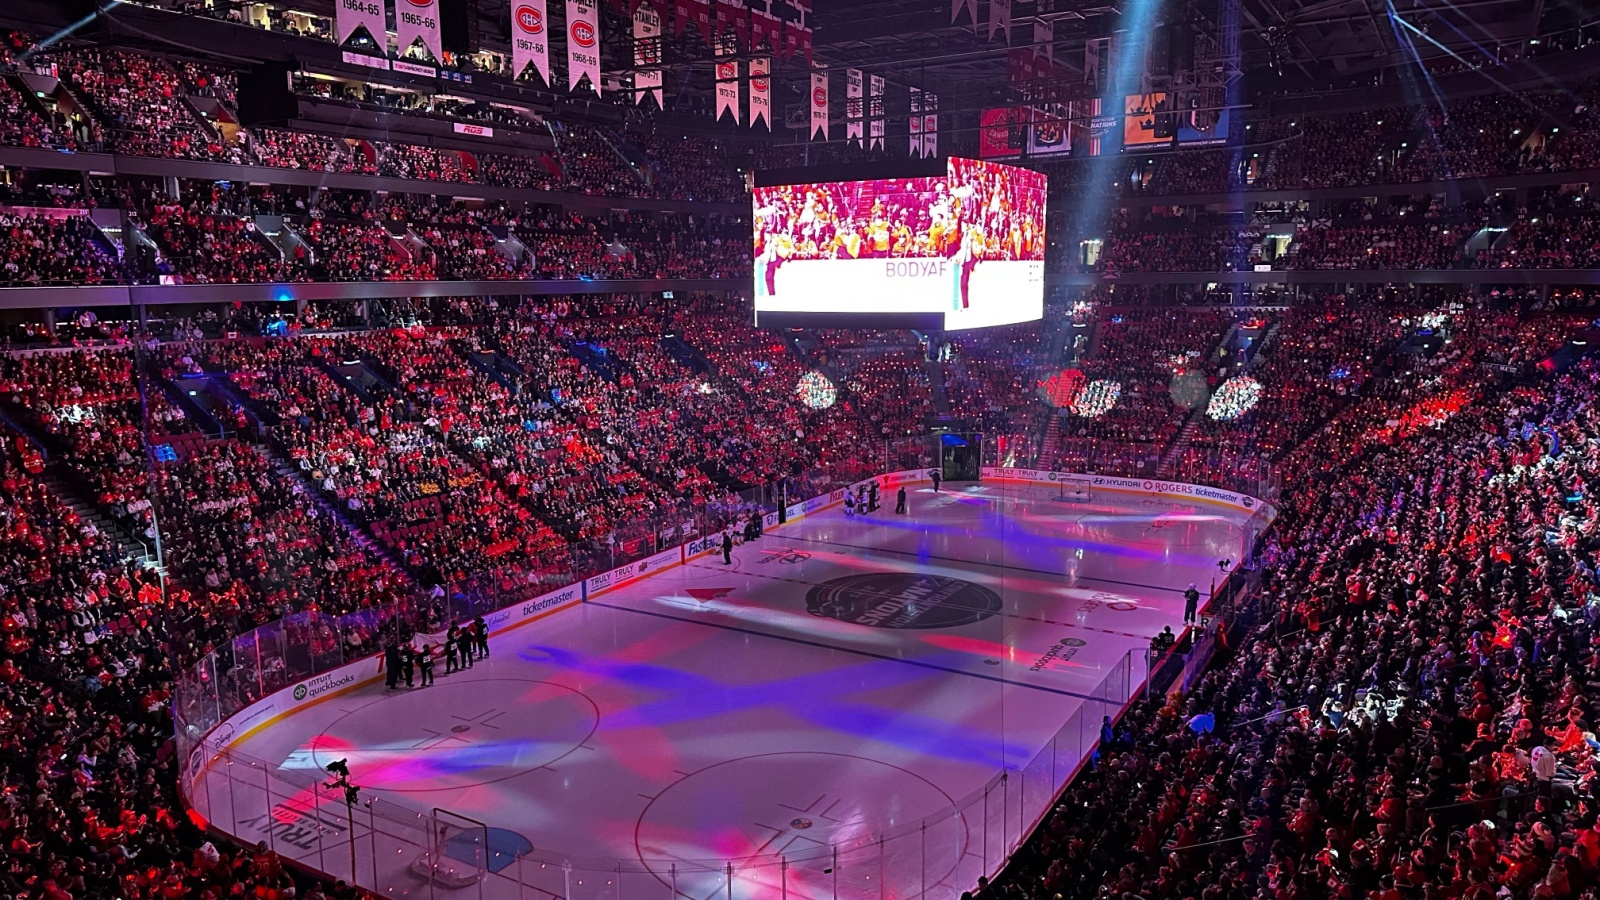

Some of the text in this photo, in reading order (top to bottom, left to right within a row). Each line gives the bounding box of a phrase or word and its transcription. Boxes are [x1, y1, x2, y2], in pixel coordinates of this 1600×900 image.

[342, 0, 380, 16] 1964-65
[400, 12, 436, 29] 1965-66
[634, 10, 660, 28] STANLEY
[516, 38, 544, 54] 1967-68
[571, 52, 597, 66] 1968-69
[718, 87, 737, 99] 1972-73
[464, 125, 484, 135] RDS
[1090, 121, 1117, 129] NATIONS
[994, 468, 1014, 476] TRULY
[1018, 469, 1038, 477] TRULY
[1106, 479, 1141, 488] HYUNDAI
[1155, 482, 1193, 494] ROGERS
[1195, 487, 1238, 503] ticketmaster
[614, 565, 634, 577] TRULY
[591, 573, 611, 586] TRULY
[523, 590, 574, 616] ticketmaster
[855, 584, 933, 626] NATIONS
[423, 655, 432, 664] 25
[308, 674, 332, 687] INTUIT
[309, 674, 355, 698] quickbooks
[238, 813, 323, 850] TRULY
